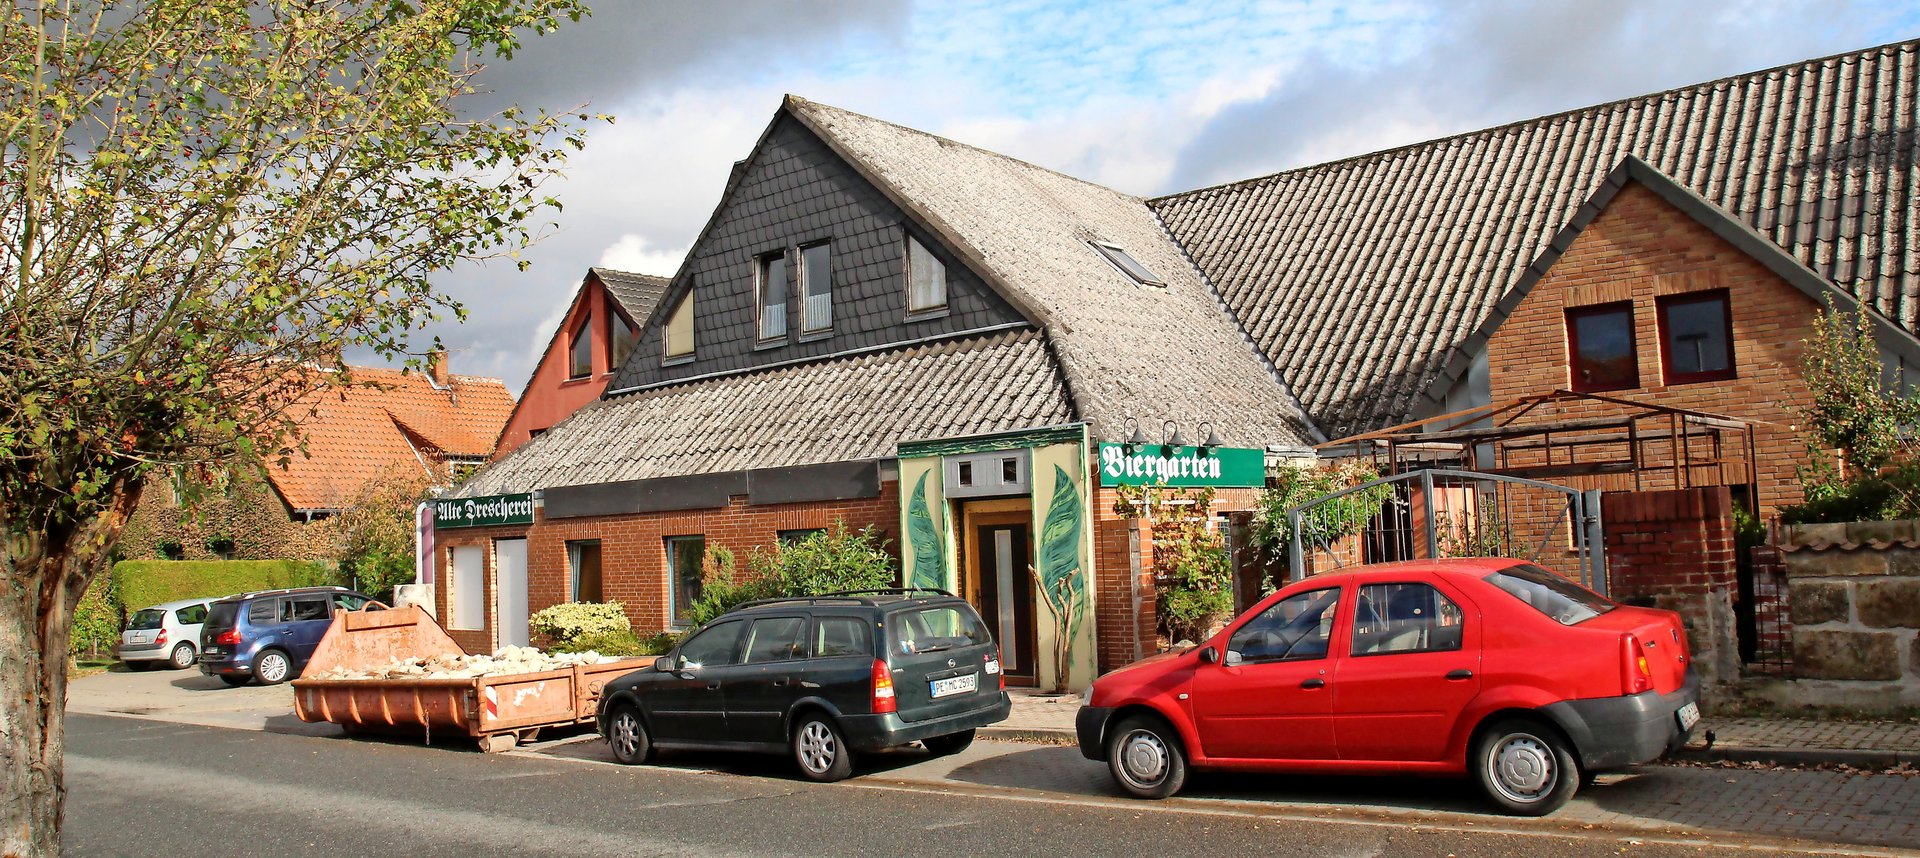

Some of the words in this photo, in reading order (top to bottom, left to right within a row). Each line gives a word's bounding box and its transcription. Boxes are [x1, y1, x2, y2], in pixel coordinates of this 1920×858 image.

[1102, 446, 1221, 483] Biergarten
[437, 501, 462, 521] Alte
[465, 495, 532, 526] Drescherei
[935, 681, 945, 693] PE
[959, 676, 974, 689] 2593
